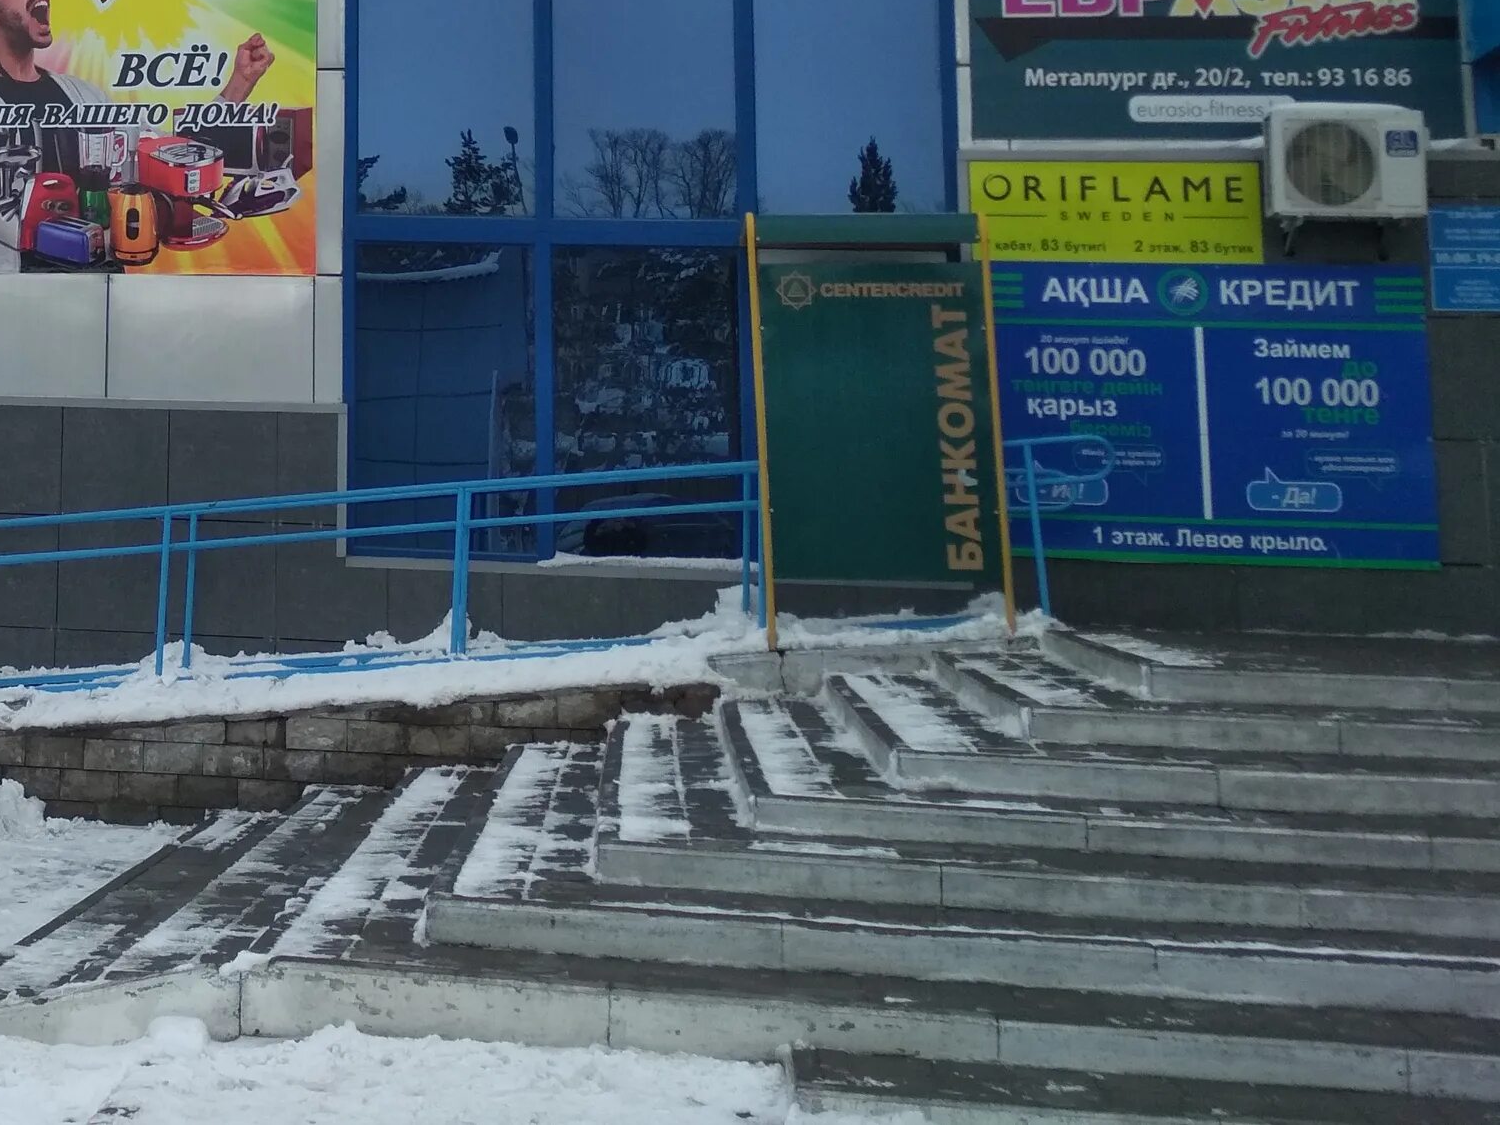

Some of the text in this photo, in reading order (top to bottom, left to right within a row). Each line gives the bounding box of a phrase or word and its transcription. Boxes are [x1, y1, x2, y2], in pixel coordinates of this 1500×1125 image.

[1246, 0, 1419, 59] Fitness
[112, 43, 229, 88] ВСЁ!
[1024, 67, 1147, 92] Металлург
[1319, 67, 1345, 87] 93
[1352, 67, 1378, 87] 16
[1384, 67, 1412, 87] 86
[41, 103, 169, 127] ВАШЕГО
[177, 102, 278, 131] ДОМА!
[982, 173, 1245, 203] ORIFLAME
[1059, 209, 1176, 222] SWEDEN
[1133, 239, 1144, 253] 2
[1190, 239, 1209, 253] 83
[819, 282, 965, 299] CENTERCREDIT
[1042, 277, 1360, 310] АҚША КРЕДИТ
[1253, 338, 1350, 360] Займем
[1025, 347, 1147, 377] 100 000
[1342, 361, 1378, 381] до
[1254, 378, 1379, 407] 100 000
[1027, 397, 1118, 420] қарыз
[1304, 406, 1380, 424] тенге
[930, 305, 984, 571] БАНКОМАТ
[1282, 486, 1317, 509] Да!
[1092, 526, 1103, 544] 1
[1111, 530, 1170, 547] этаж.
[1175, 529, 1244, 549] Левое
